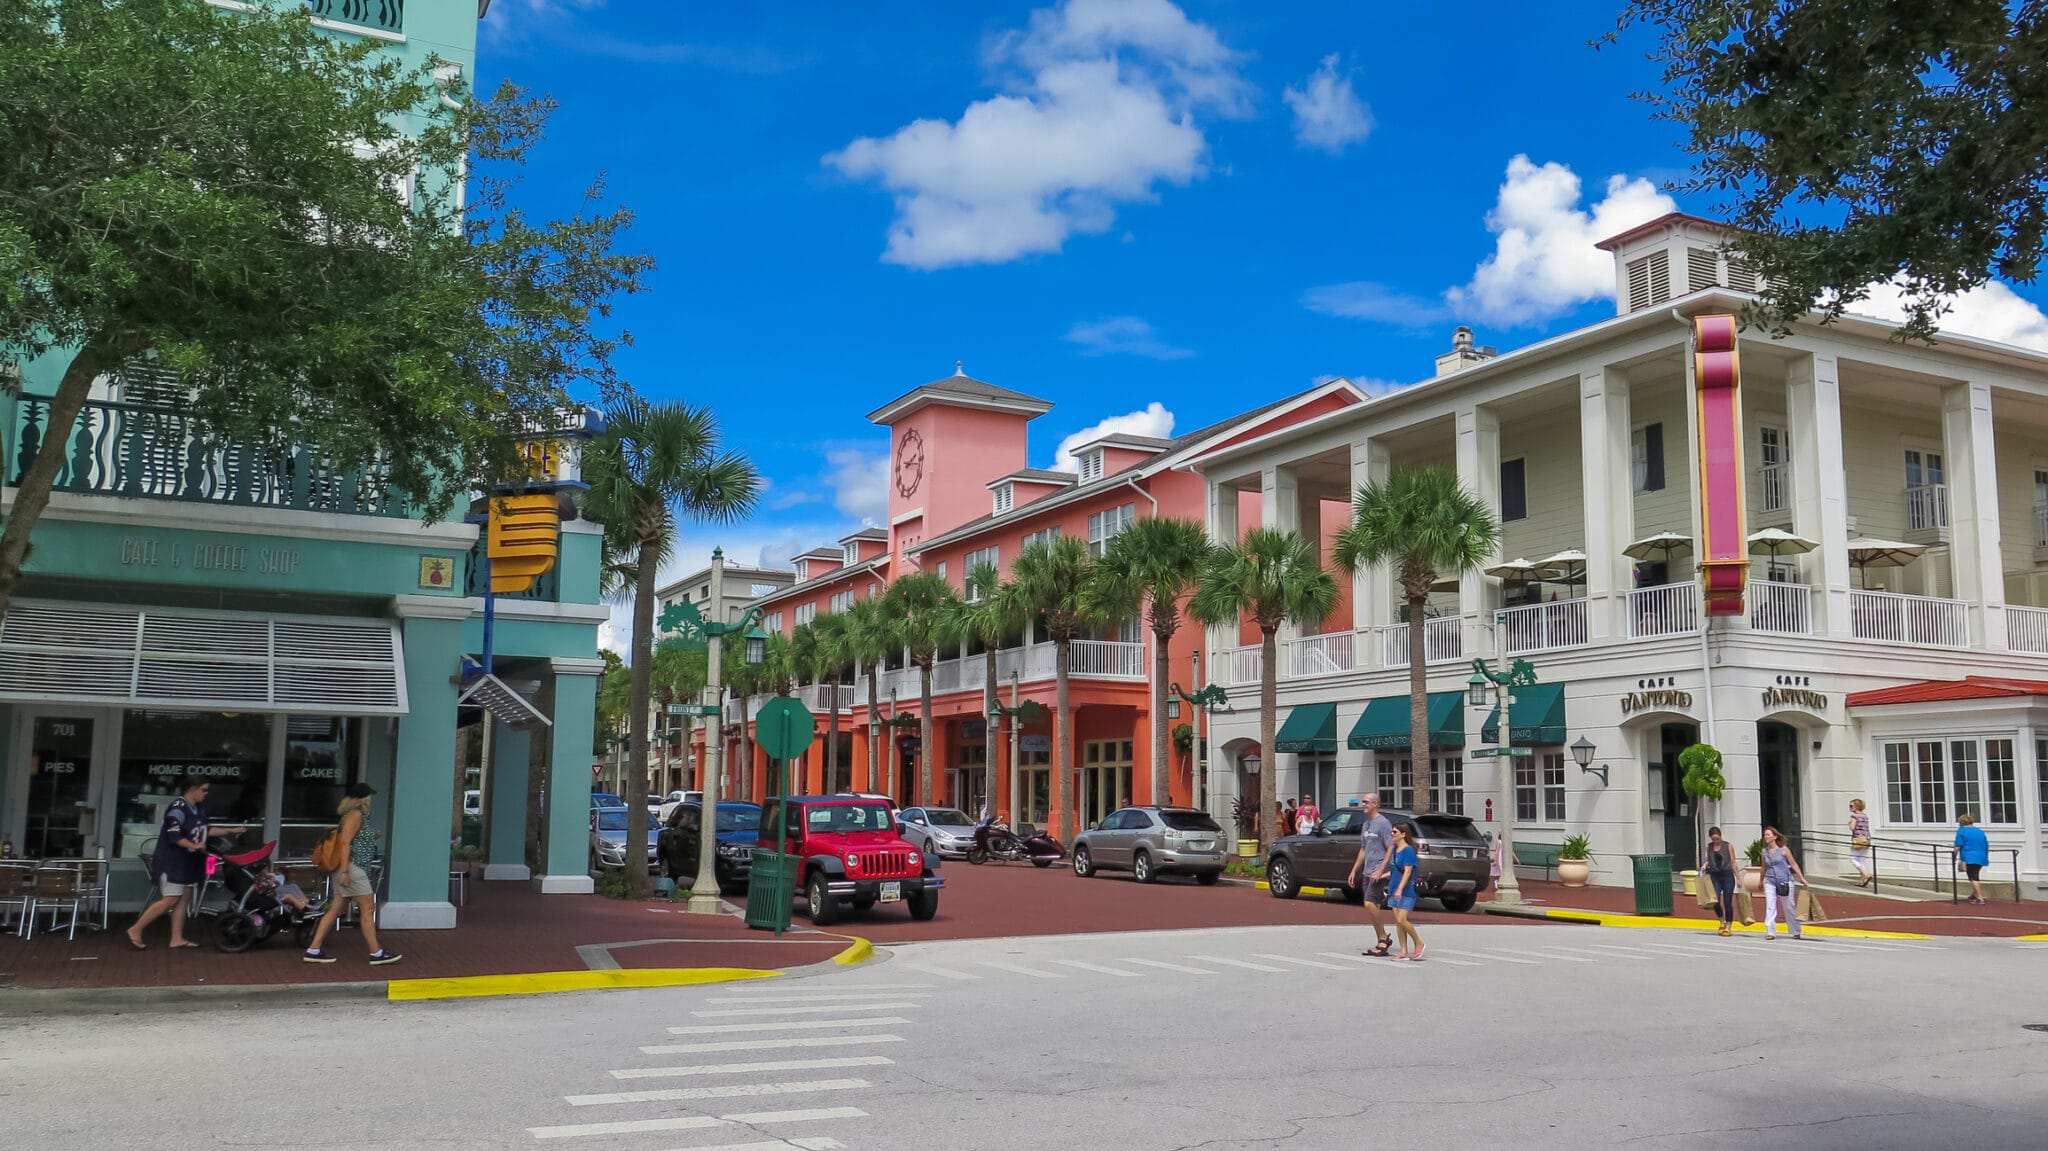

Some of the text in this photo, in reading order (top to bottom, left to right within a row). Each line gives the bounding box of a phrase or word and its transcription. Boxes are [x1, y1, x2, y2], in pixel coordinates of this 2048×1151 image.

[121, 536, 160, 566] CAFE
[194, 543, 248, 573] COFFEE
[259, 547, 300, 574] SHOP
[1639, 677, 1674, 688] CAFE
[1776, 675, 1809, 685] CAFE
[1621, 690, 1692, 713] D'ANTONIO
[1762, 687, 1827, 709] D'ANTONIO
[52, 724, 75, 736] 701
[45, 762, 75, 773] PIES
[149, 764, 240, 776] HOME COOKING
[301, 768, 343, 778] CAKES
